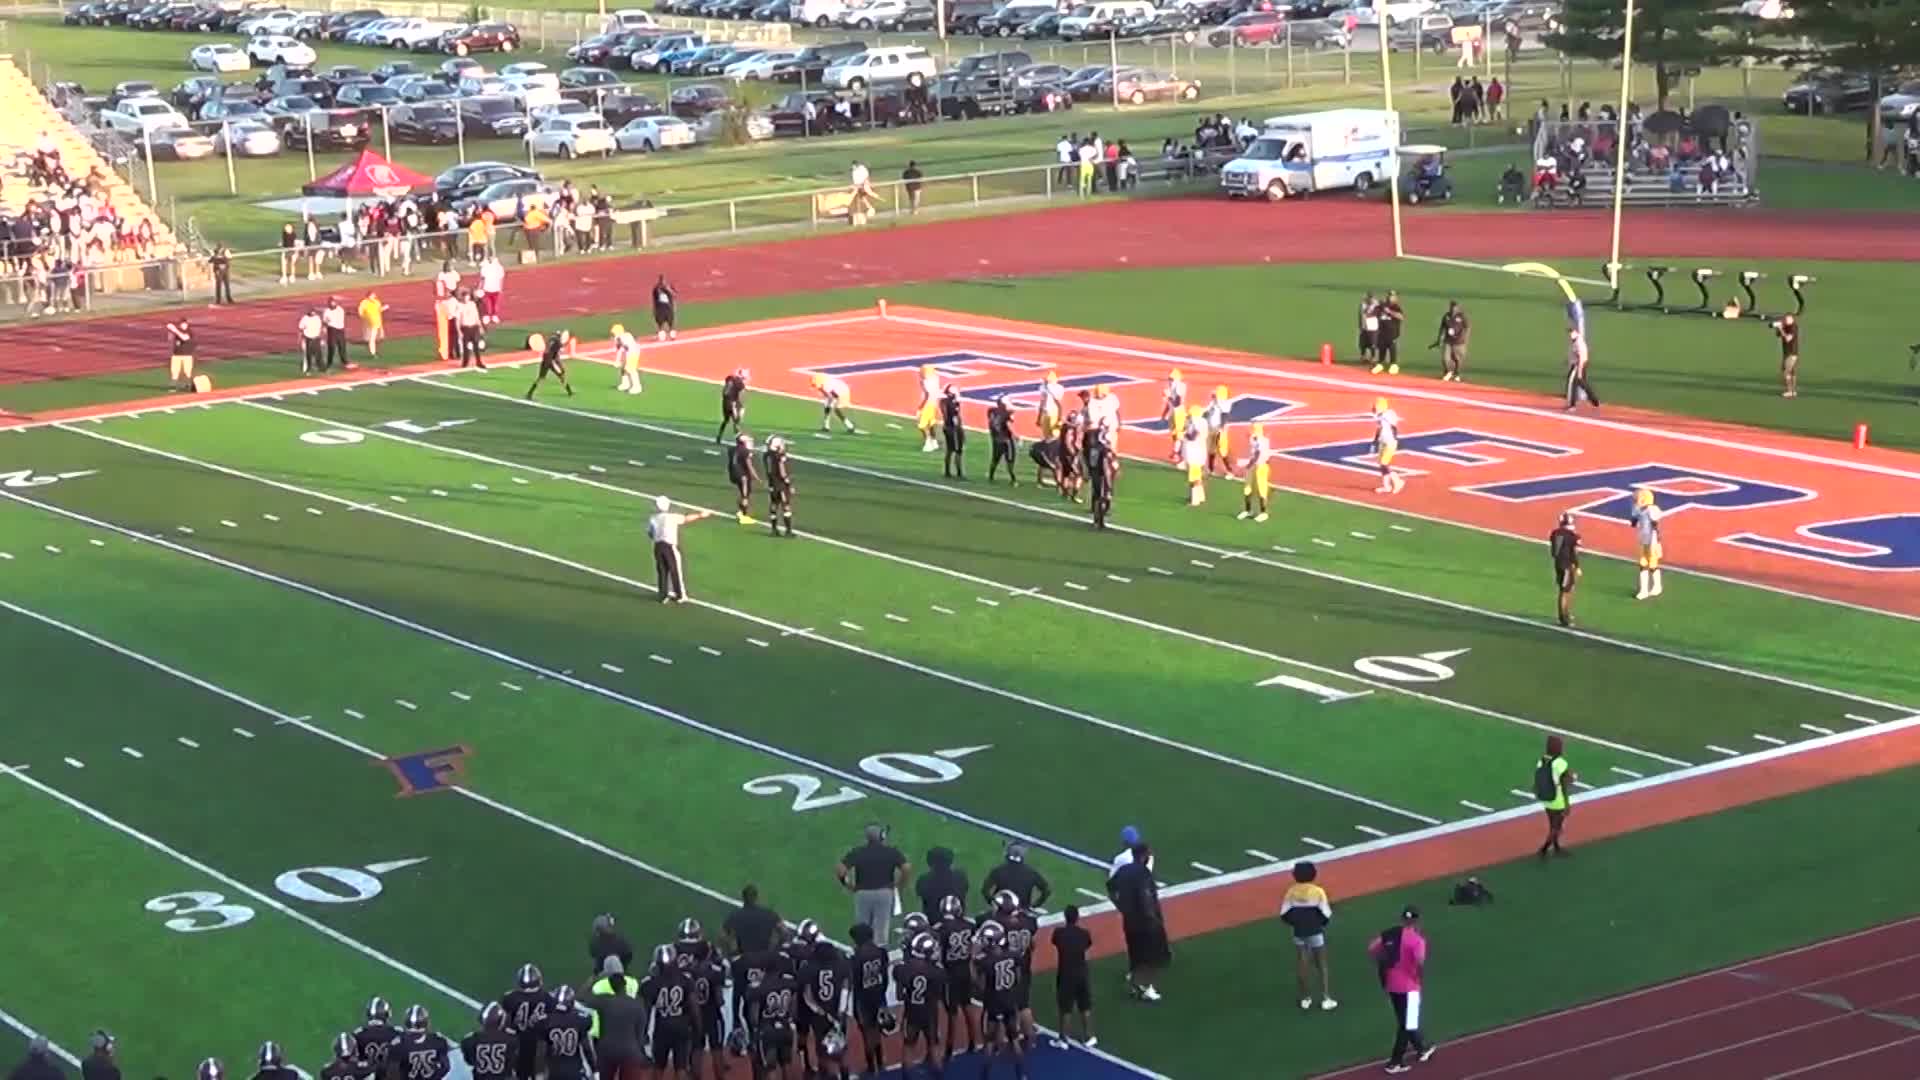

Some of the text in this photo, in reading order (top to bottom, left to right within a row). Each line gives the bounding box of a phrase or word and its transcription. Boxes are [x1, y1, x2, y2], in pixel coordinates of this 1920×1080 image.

[1255, 655, 1455, 704] 10
[368, 744, 478, 800] F
[742, 752, 964, 812] 20
[143, 866, 383, 933] 30
[654, 984, 685, 1018] 42
[818, 968, 835, 1002] 5
[910, 974, 929, 1005] 2
[407, 1048, 438, 1080] 75
[475, 1042, 508, 1075] 55
